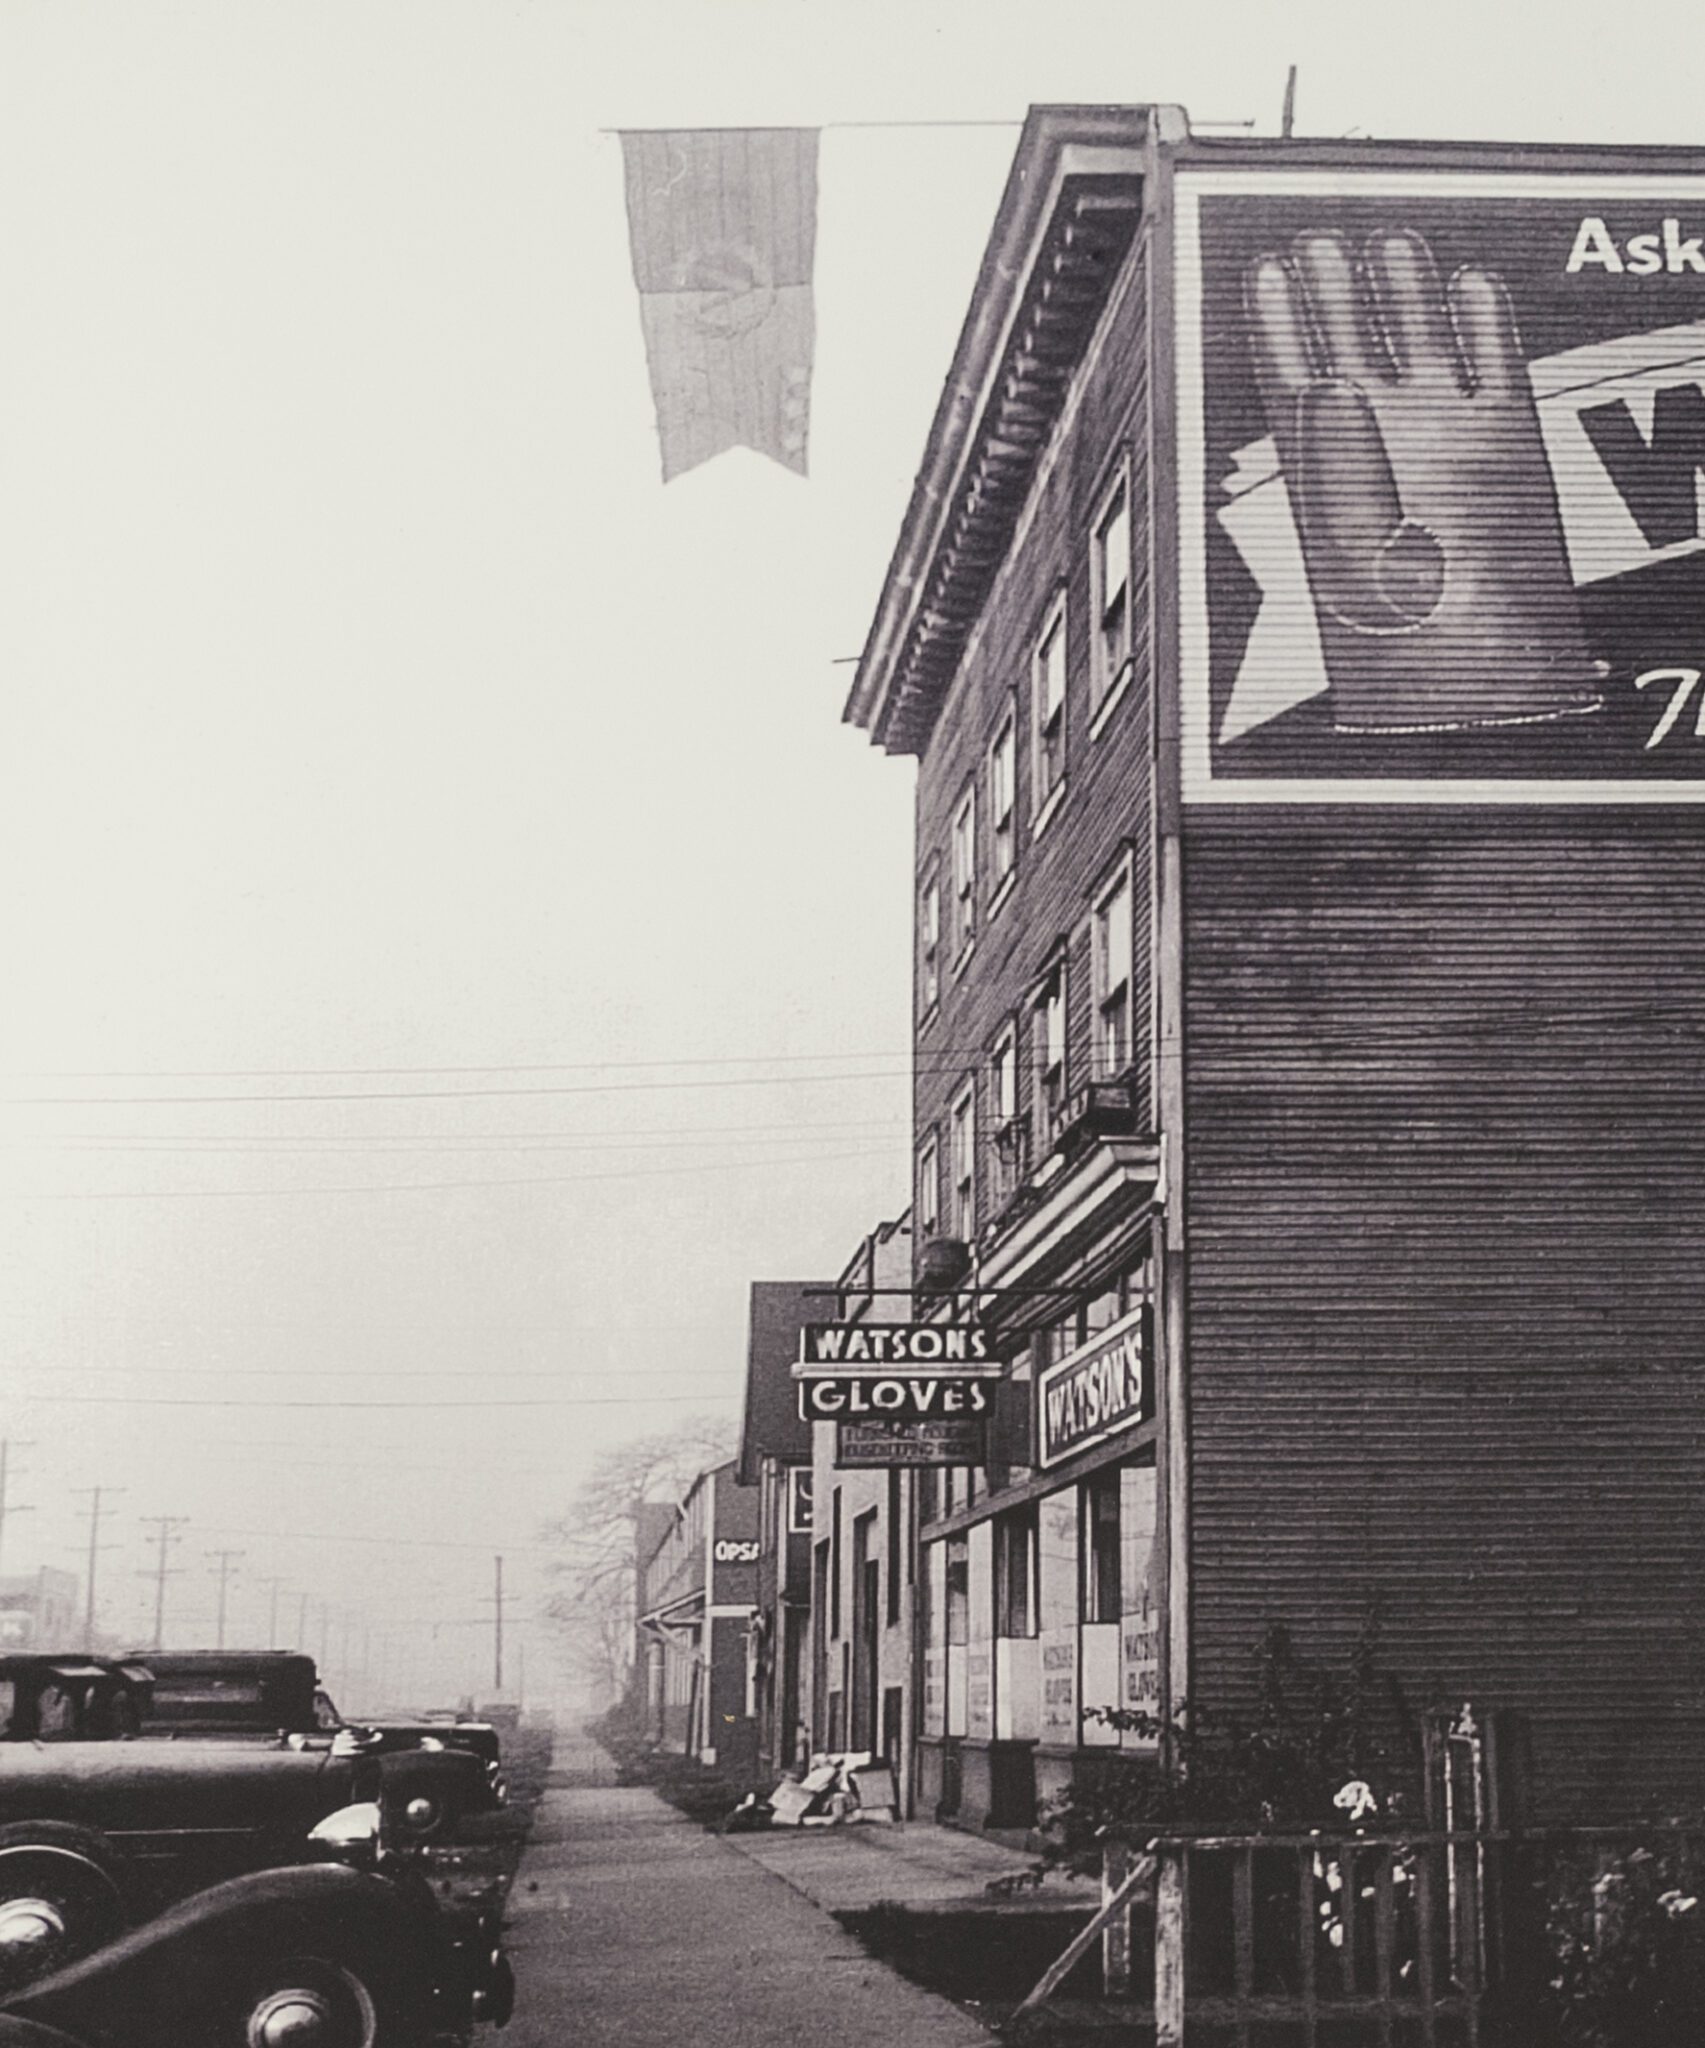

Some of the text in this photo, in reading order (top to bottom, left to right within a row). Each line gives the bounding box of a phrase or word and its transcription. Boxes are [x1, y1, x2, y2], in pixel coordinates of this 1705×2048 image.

[1565, 217, 1705, 275] Ask
[815, 1328, 987, 1360] WATSONS
[811, 1379, 987, 1412] GLOVES
